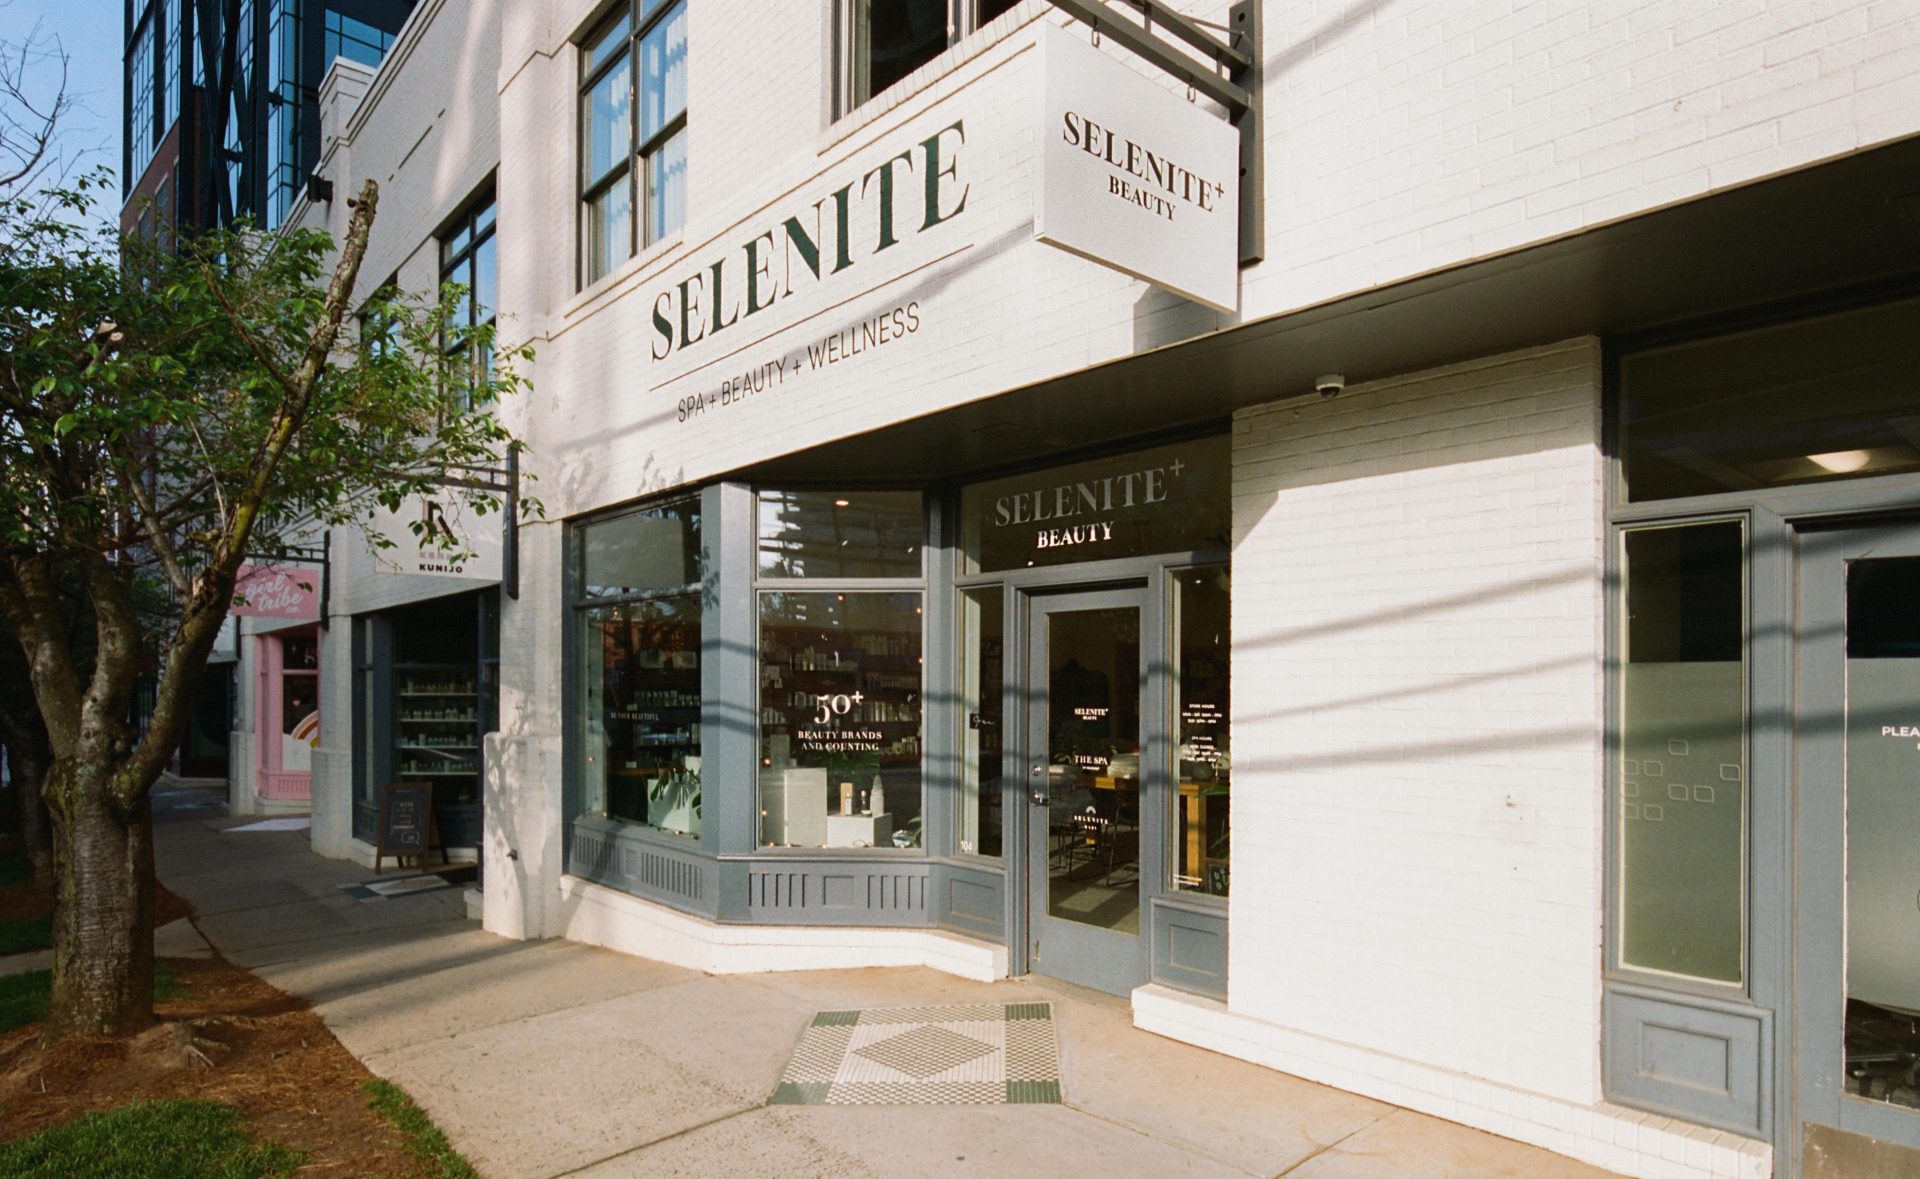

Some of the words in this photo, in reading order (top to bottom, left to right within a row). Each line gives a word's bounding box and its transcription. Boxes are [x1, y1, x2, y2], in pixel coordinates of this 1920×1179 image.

[1108, 175, 1176, 221] BEAUTY
[651, 118, 970, 361] SELENITE
[678, 391, 705, 423] SPA
[721, 355, 788, 407] BEAUTY
[807, 301, 921, 371] WELLNESS
[1036, 521, 1114, 549] BEAUTY
[419, 563, 463, 573] KUNIJO
[245, 572, 286, 601] girl
[258, 586, 304, 612] tribe
[798, 730, 838, 740] BEAUTY
[841, 731, 883, 740] BRANDS
[801, 742, 823, 750] AND
[825, 742, 879, 751] COUNTING
[1074, 754, 1092, 764] THE
[1093, 755, 1108, 765] SPA
